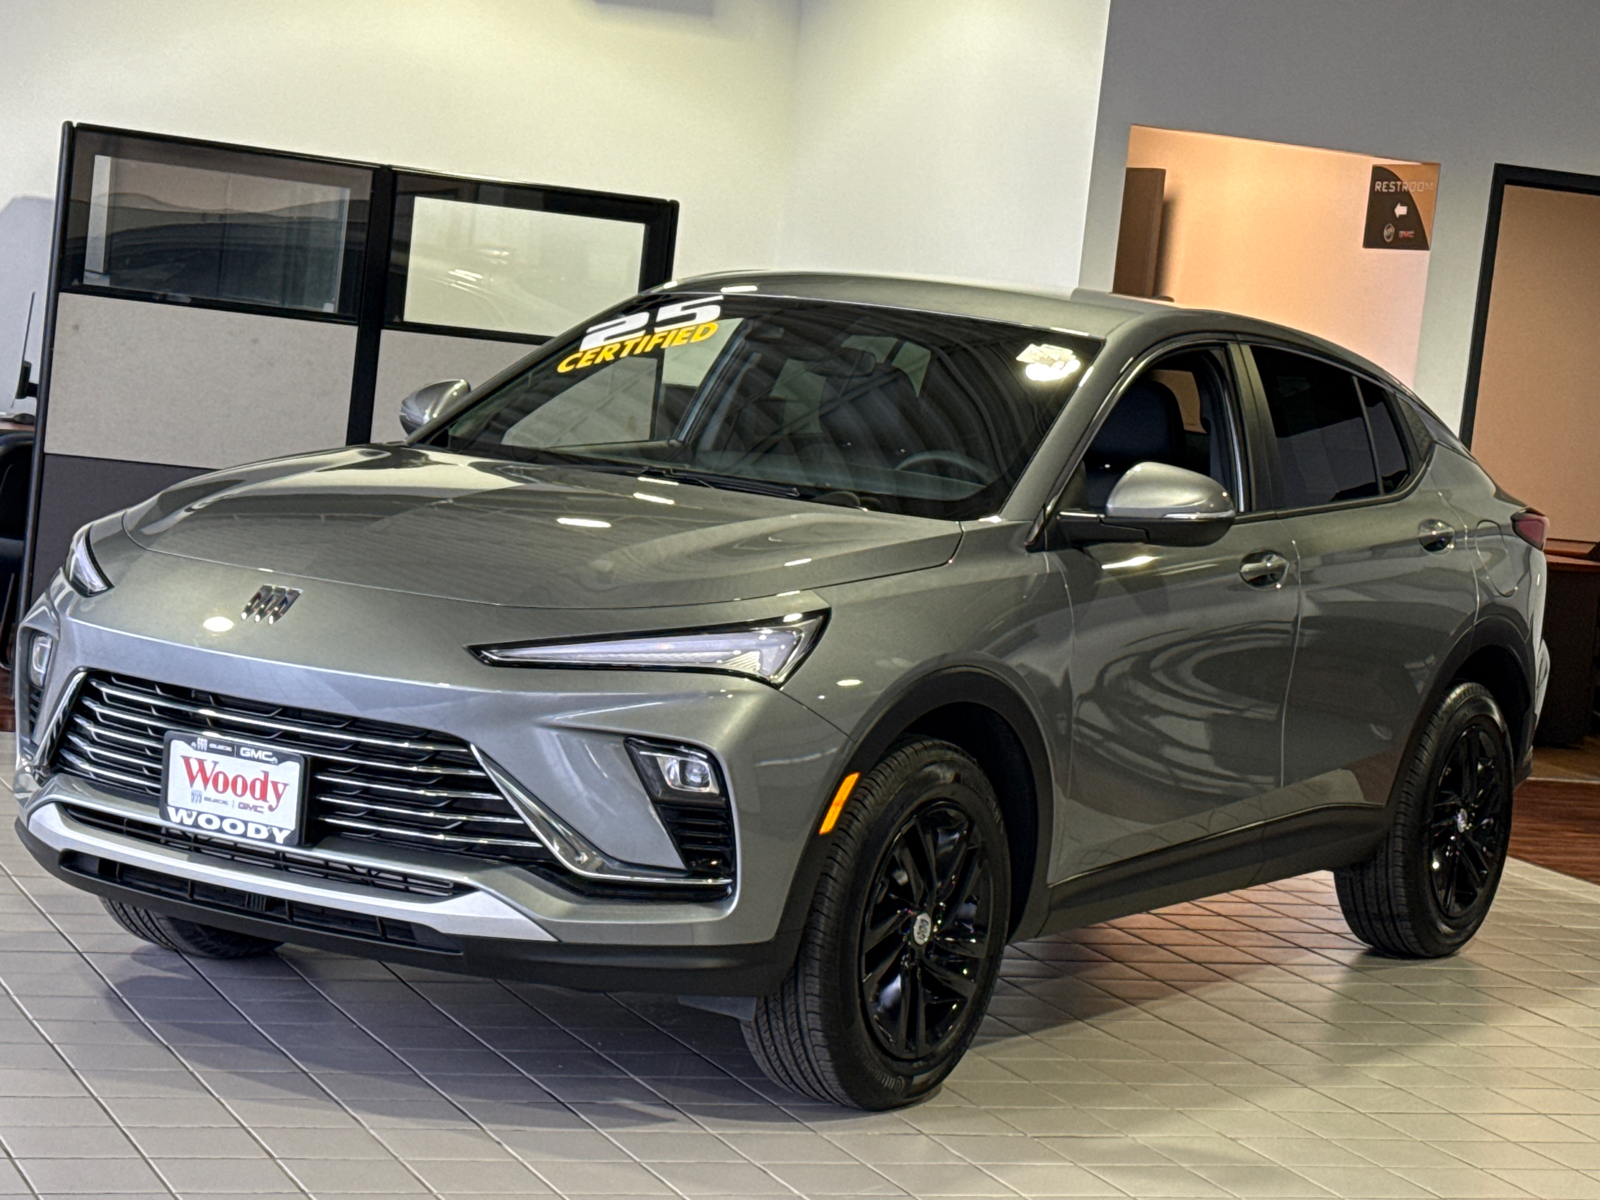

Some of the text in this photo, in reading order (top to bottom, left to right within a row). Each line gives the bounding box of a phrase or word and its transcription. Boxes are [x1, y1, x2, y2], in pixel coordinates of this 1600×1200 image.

[578, 295, 724, 352] 25
[556, 321, 719, 373] CERTIFIED
[240, 746, 274, 762] GMC
[180, 755, 290, 812] Woody
[166, 805, 294, 845] WOODY
[237, 801, 265, 814] GMC
